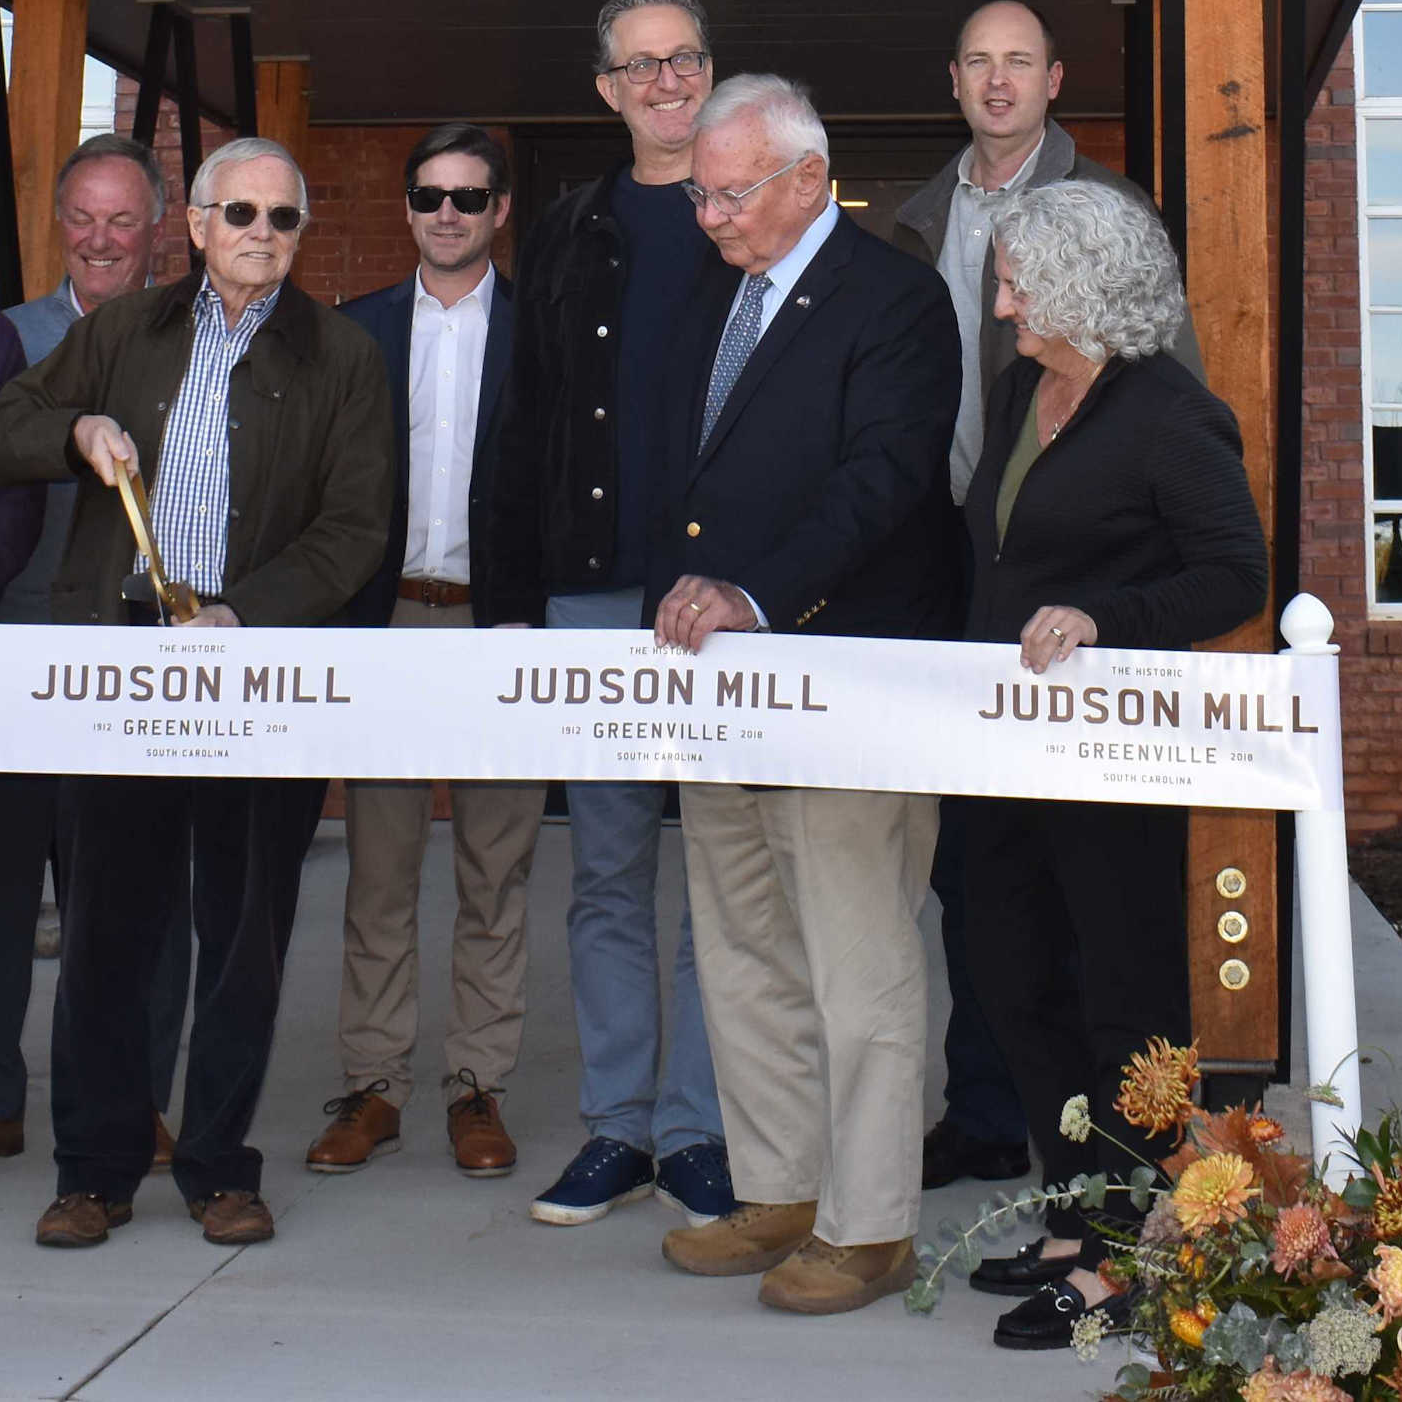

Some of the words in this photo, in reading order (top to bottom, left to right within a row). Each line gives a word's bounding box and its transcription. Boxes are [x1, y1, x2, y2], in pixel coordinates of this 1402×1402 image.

[158, 645, 177, 654] THE
[180, 645, 226, 654] HISTORIC
[628, 647, 648, 656] THE
[1111, 666, 1131, 676] THE
[1135, 667, 1184, 678] HISTORIC
[31, 665, 222, 703] JUDSON
[243, 666, 352, 704] MILL
[498, 667, 695, 706] JUDSON
[717, 671, 828, 712] MILL
[978, 683, 1180, 728] JUDSON
[1204, 692, 1319, 734] MILL
[92, 723, 112, 732] 1912
[124, 719, 255, 737] GREENVILLE
[265, 725, 288, 733] 2018
[561, 726, 581, 735] 1912
[593, 722, 729, 742] GREENVILLE
[740, 730, 764, 739] 2018
[146, 749, 178, 758] SOUTH
[181, 749, 230, 758] CAROLINA
[616, 752, 650, 761] SOUTH
[653, 753, 704, 762] CAROLINA
[1045, 744, 1066, 754] 1912
[1079, 742, 1218, 765] GREENVILLE
[1230, 753, 1254, 762] 2018
[1102, 774, 1138, 783] SOUTH
[1141, 775, 1193, 786] CAROLINA
